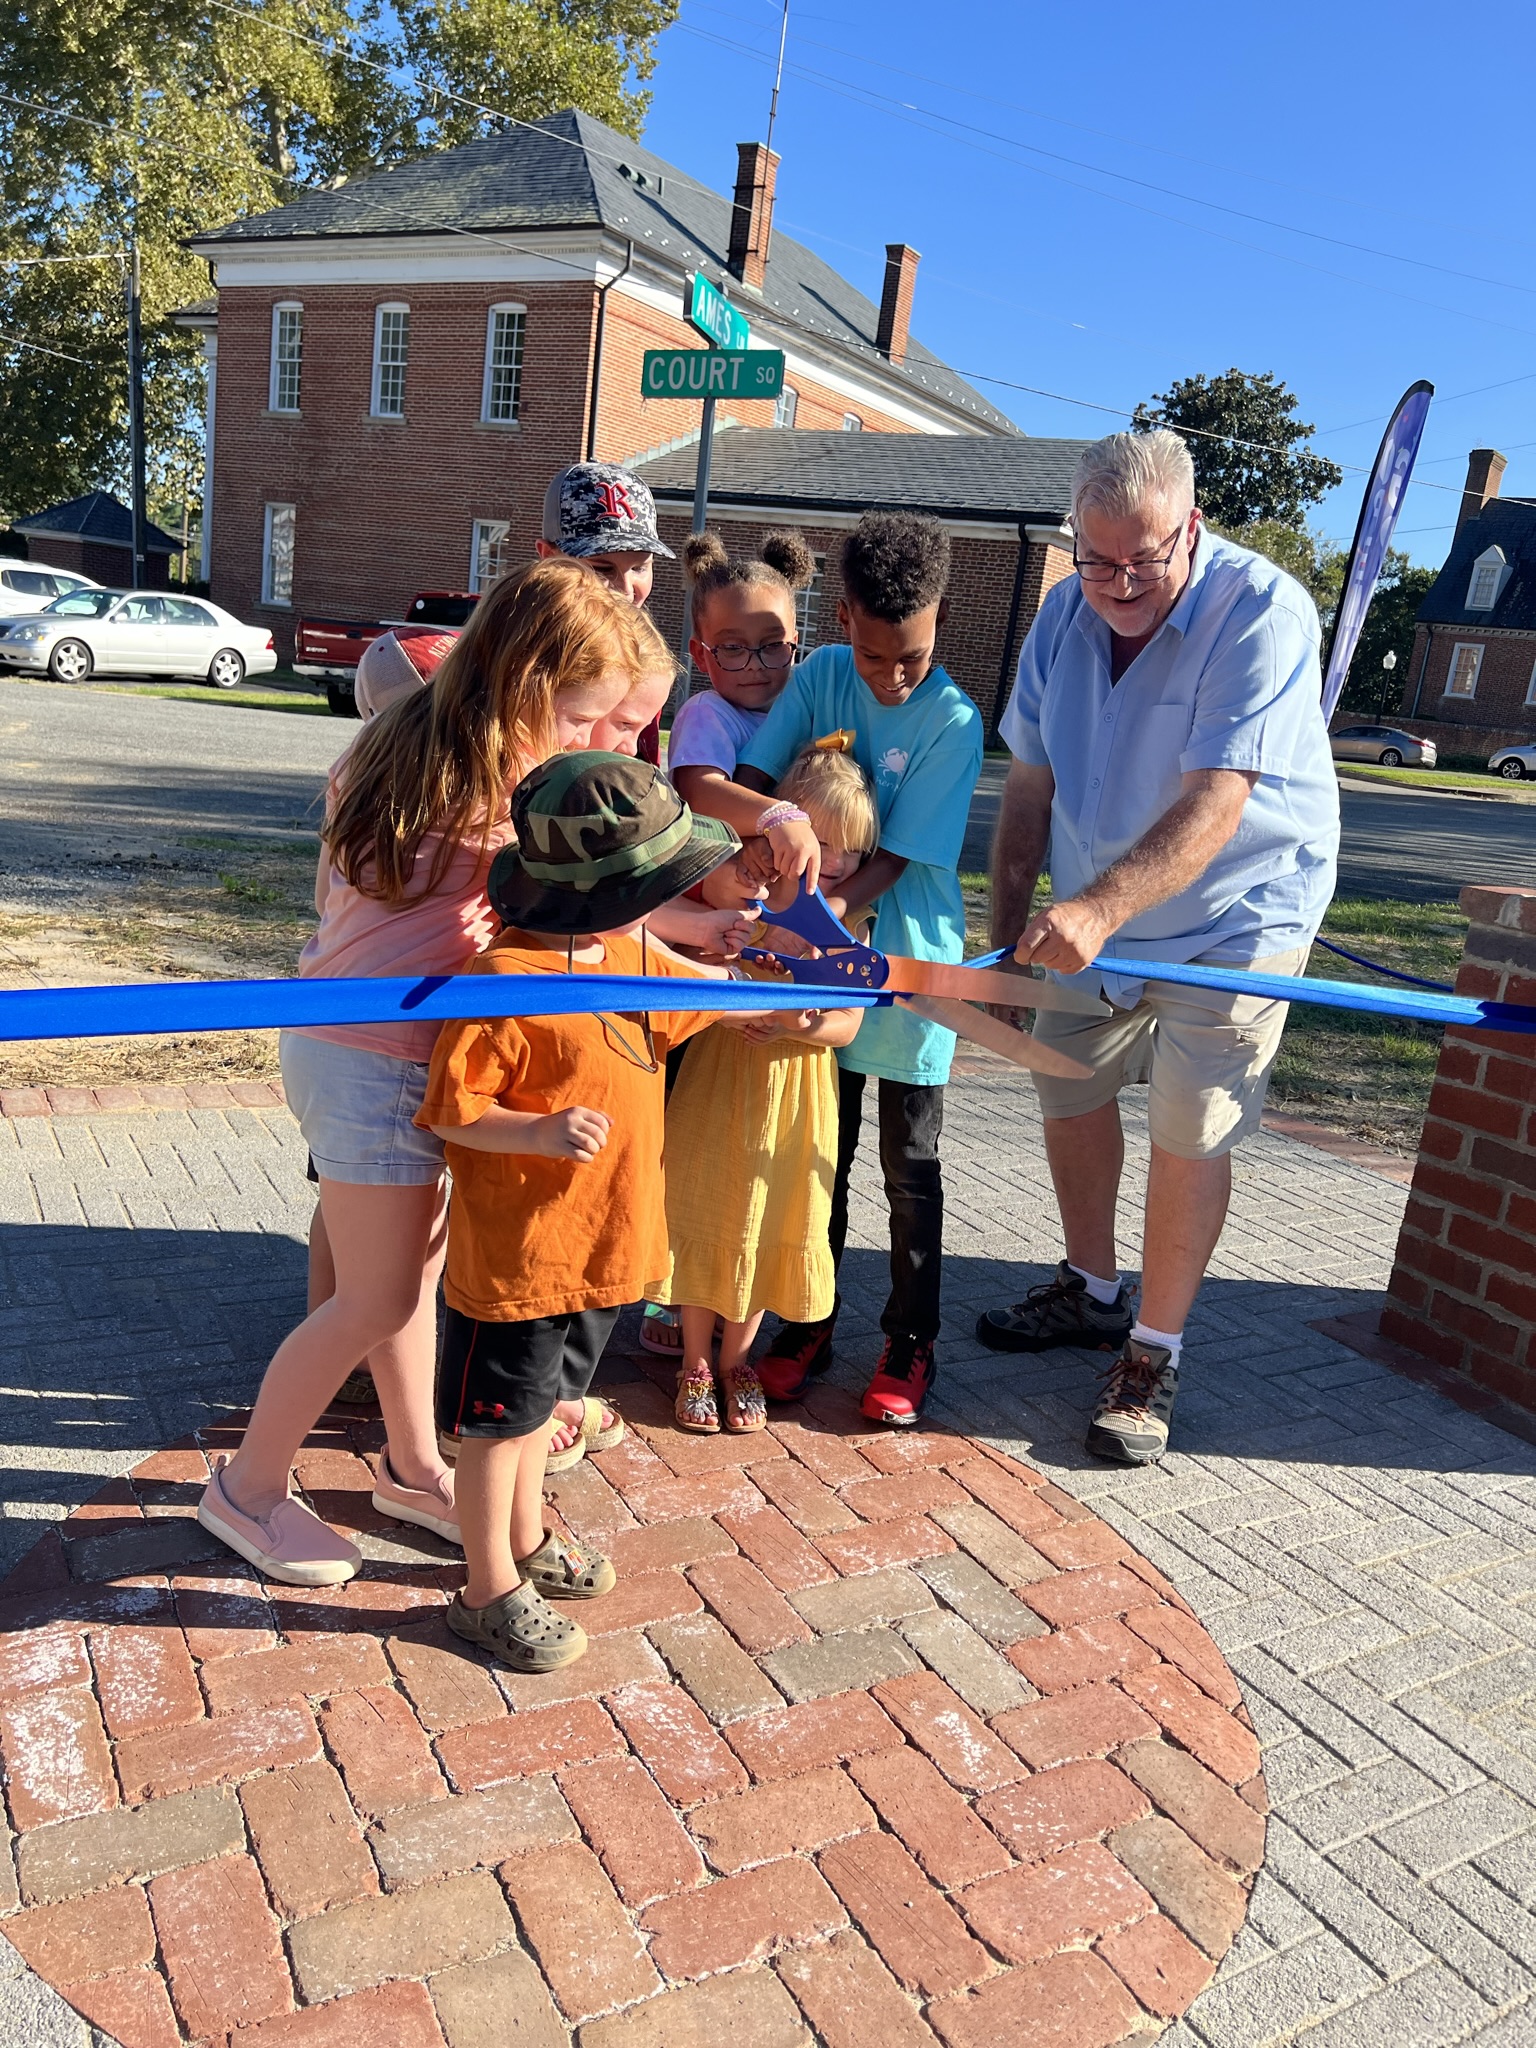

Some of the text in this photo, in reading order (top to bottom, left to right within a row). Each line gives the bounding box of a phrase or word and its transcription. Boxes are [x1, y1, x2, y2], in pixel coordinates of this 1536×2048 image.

[696, 284, 732, 346] AMES
[648, 356, 776, 390] COURT SQ
[594, 481, 638, 521] R
